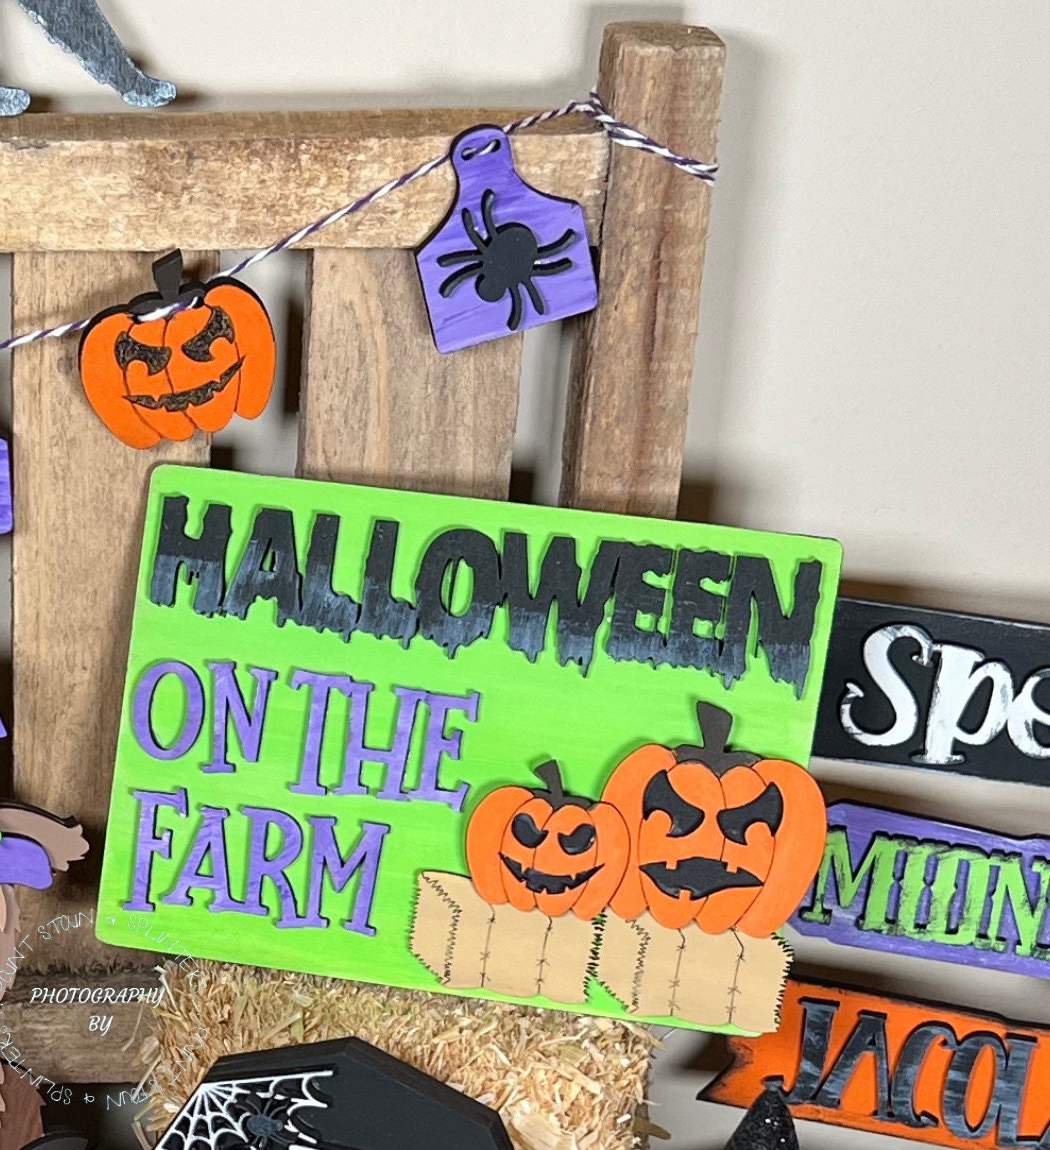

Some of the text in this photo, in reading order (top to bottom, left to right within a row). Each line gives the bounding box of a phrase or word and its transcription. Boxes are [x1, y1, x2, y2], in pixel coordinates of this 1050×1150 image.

[150, 493, 822, 700] HALLOWEEN
[128, 660, 481, 812] ON THE
[120, 787, 391, 937] FARM
